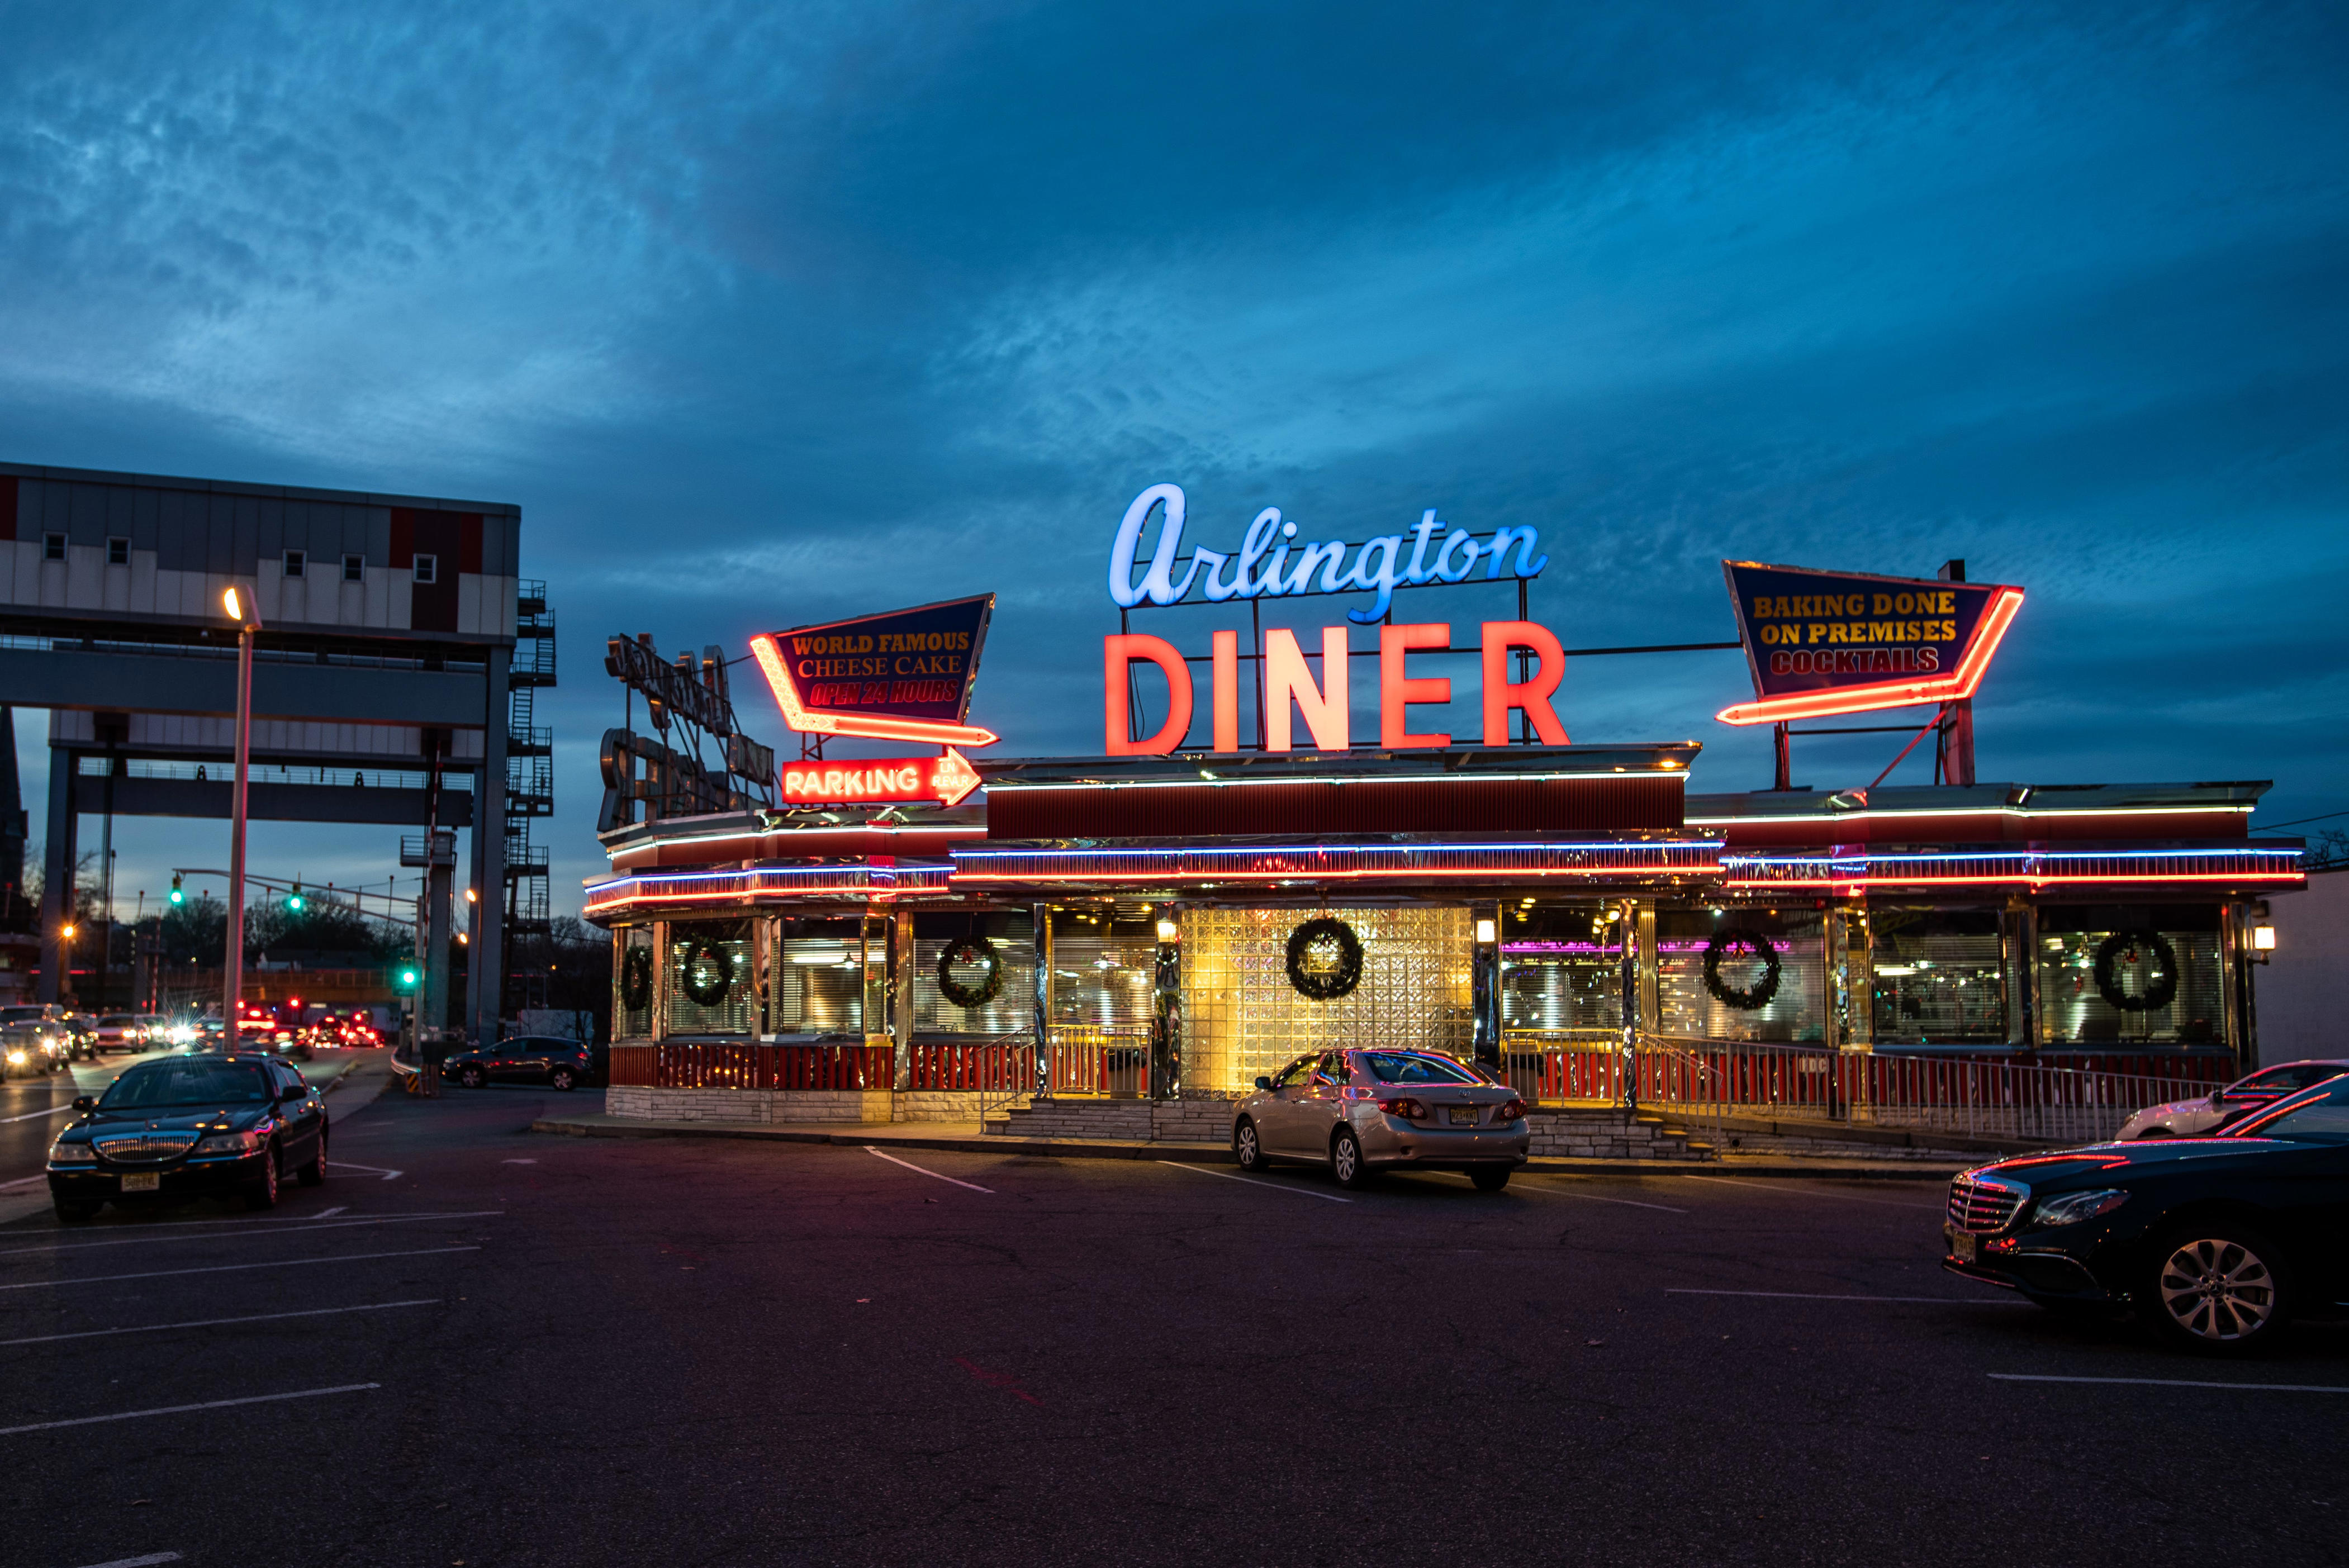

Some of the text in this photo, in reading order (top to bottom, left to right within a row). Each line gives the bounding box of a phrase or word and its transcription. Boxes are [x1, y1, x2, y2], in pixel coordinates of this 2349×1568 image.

[1108, 482, 1550, 625] Arlington
[1754, 591, 1956, 617] BAKING DONE
[793, 631, 969, 655] WORLD FAMOUS
[1760, 620, 1956, 644] ON PREMISES
[798, 655, 962, 678] CHEESE CAKE
[1771, 647, 1938, 675] COCKTAILS
[810, 679, 959, 705] OPEN 24 HOURS
[1104, 621, 1572, 756] DINER
[786, 768, 918, 795] PARKING
[932, 775, 969, 787] REAR
